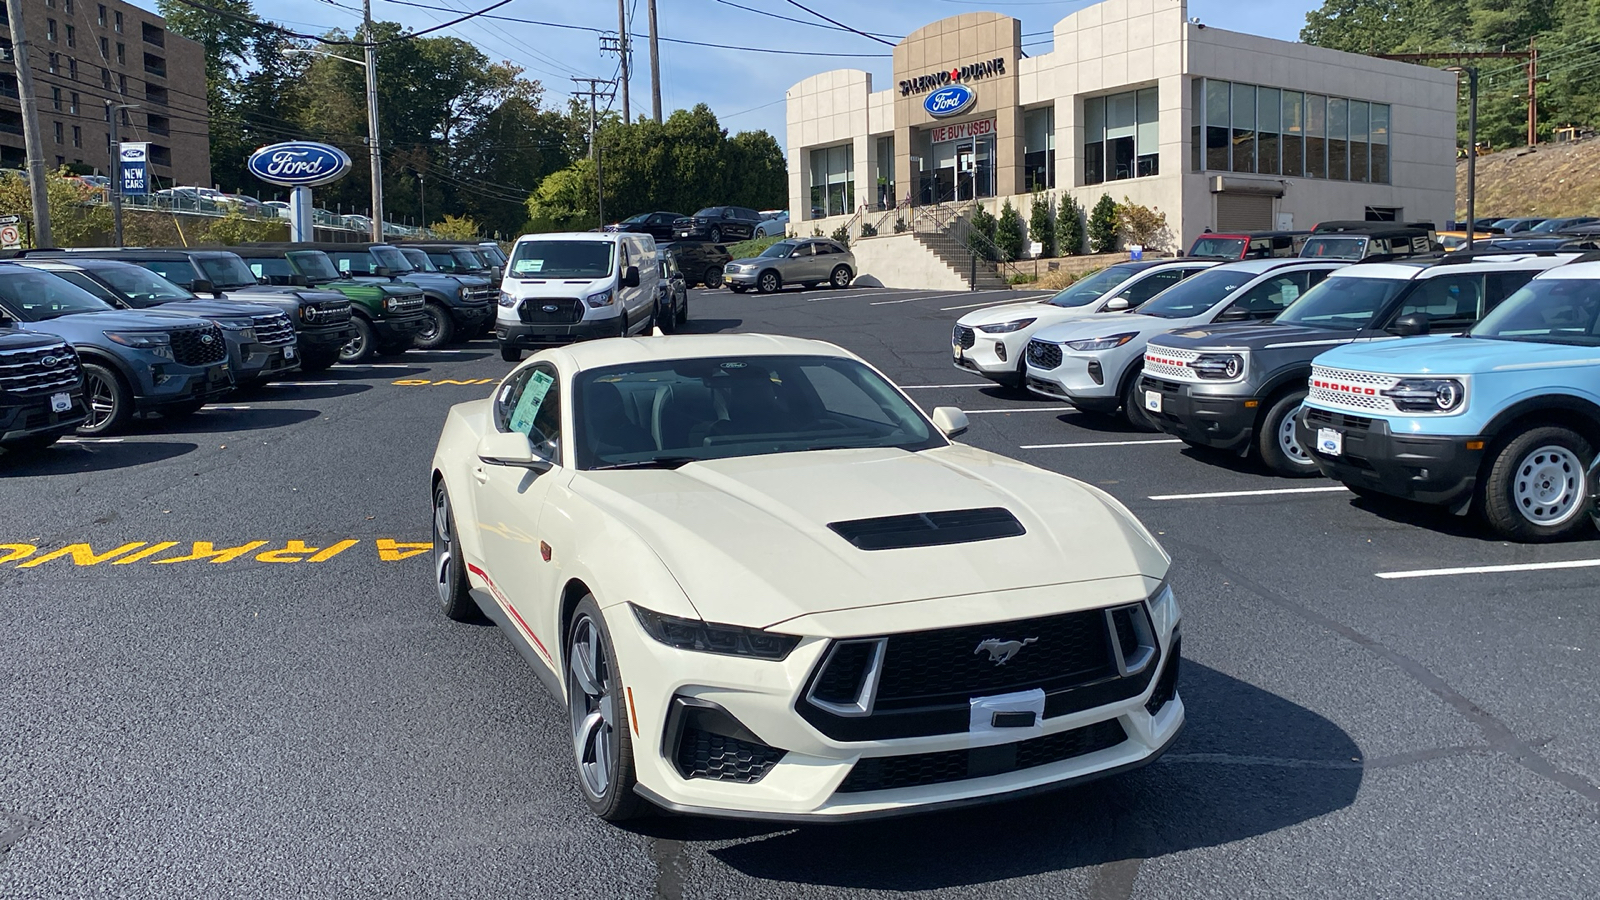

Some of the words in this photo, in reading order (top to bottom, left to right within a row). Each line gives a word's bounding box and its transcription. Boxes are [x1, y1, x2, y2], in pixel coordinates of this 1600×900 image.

[899, 71, 951, 96] SALERNO
[960, 57, 1005, 80] DUANE
[932, 91, 960, 111] Ford
[932, 127, 946, 142] WE
[947, 124, 965, 139] BUY
[967, 119, 991, 137] USED
[267, 151, 324, 175] Ford
[124, 168, 143, 179] NEW
[125, 179, 144, 189] CARS
[1146, 355, 1184, 367] BRONCO
[1314, 380, 1376, 395] BRONCO
